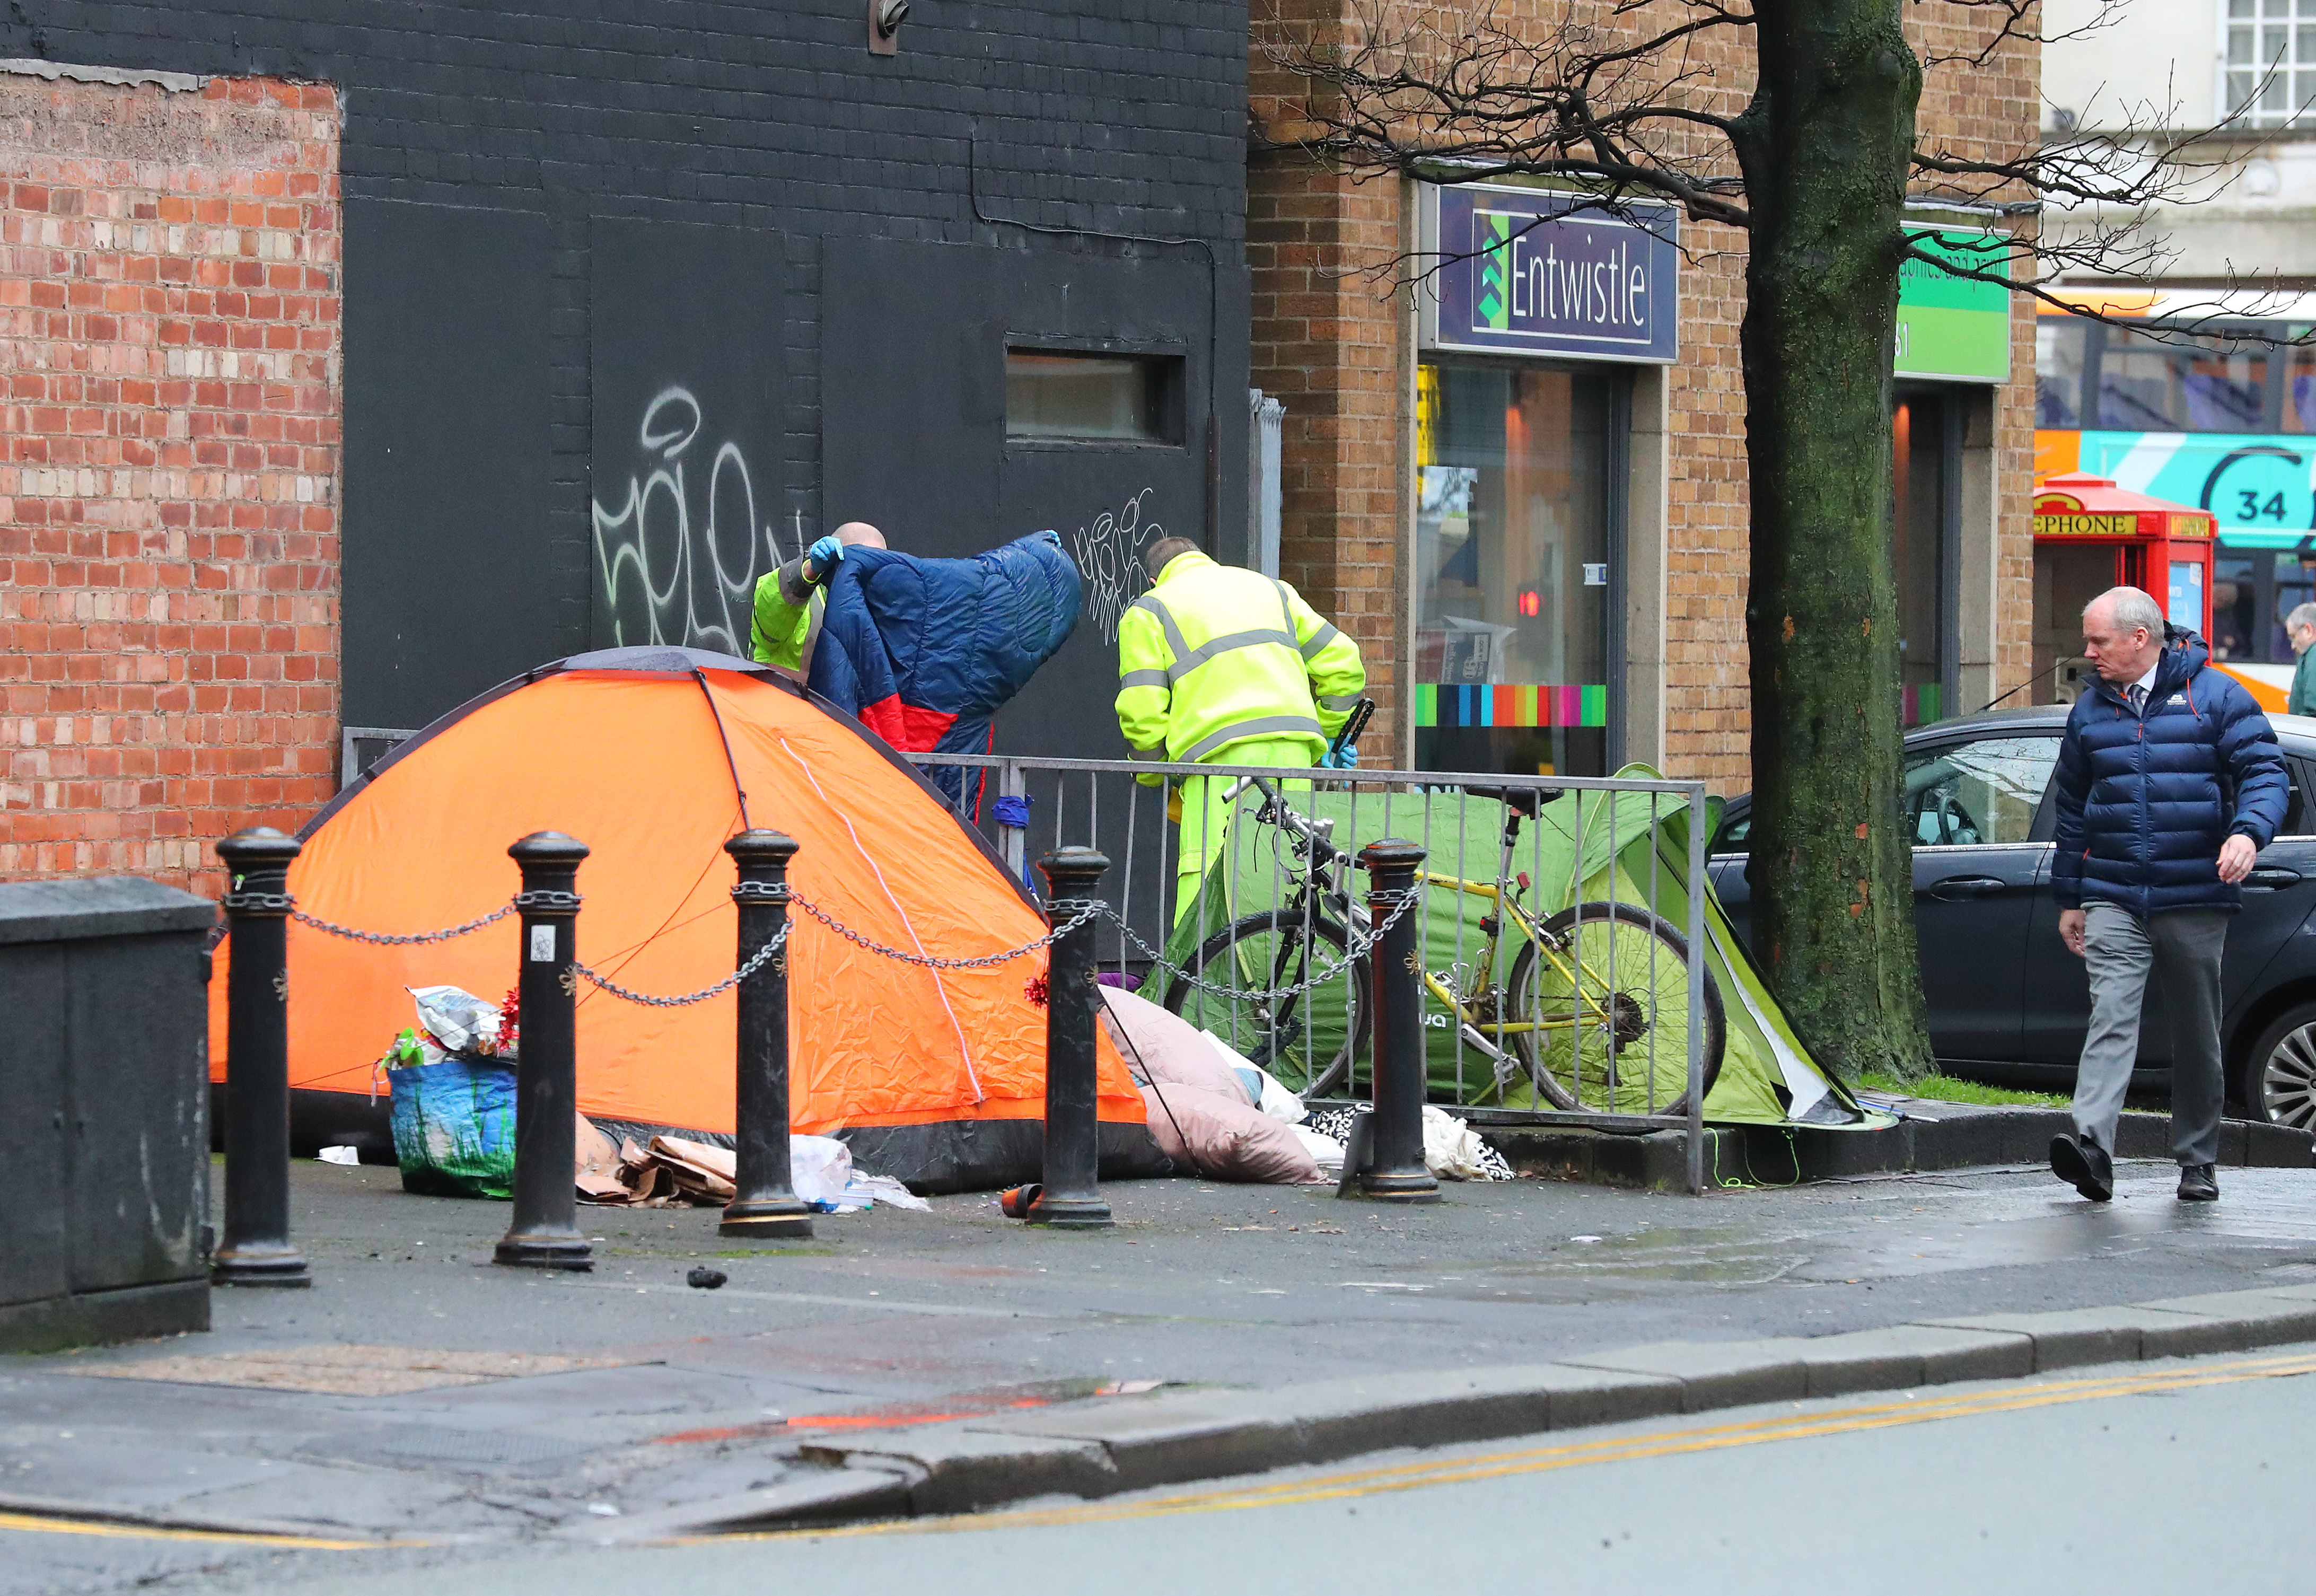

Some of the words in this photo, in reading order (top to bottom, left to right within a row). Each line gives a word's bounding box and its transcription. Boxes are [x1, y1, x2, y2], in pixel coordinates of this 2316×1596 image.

[1512, 233, 1645, 327] Entwistle
[1894, 321, 1909, 357] 61
[2238, 492, 2286, 521] 34
[2033, 516, 2126, 534] EPHONE
